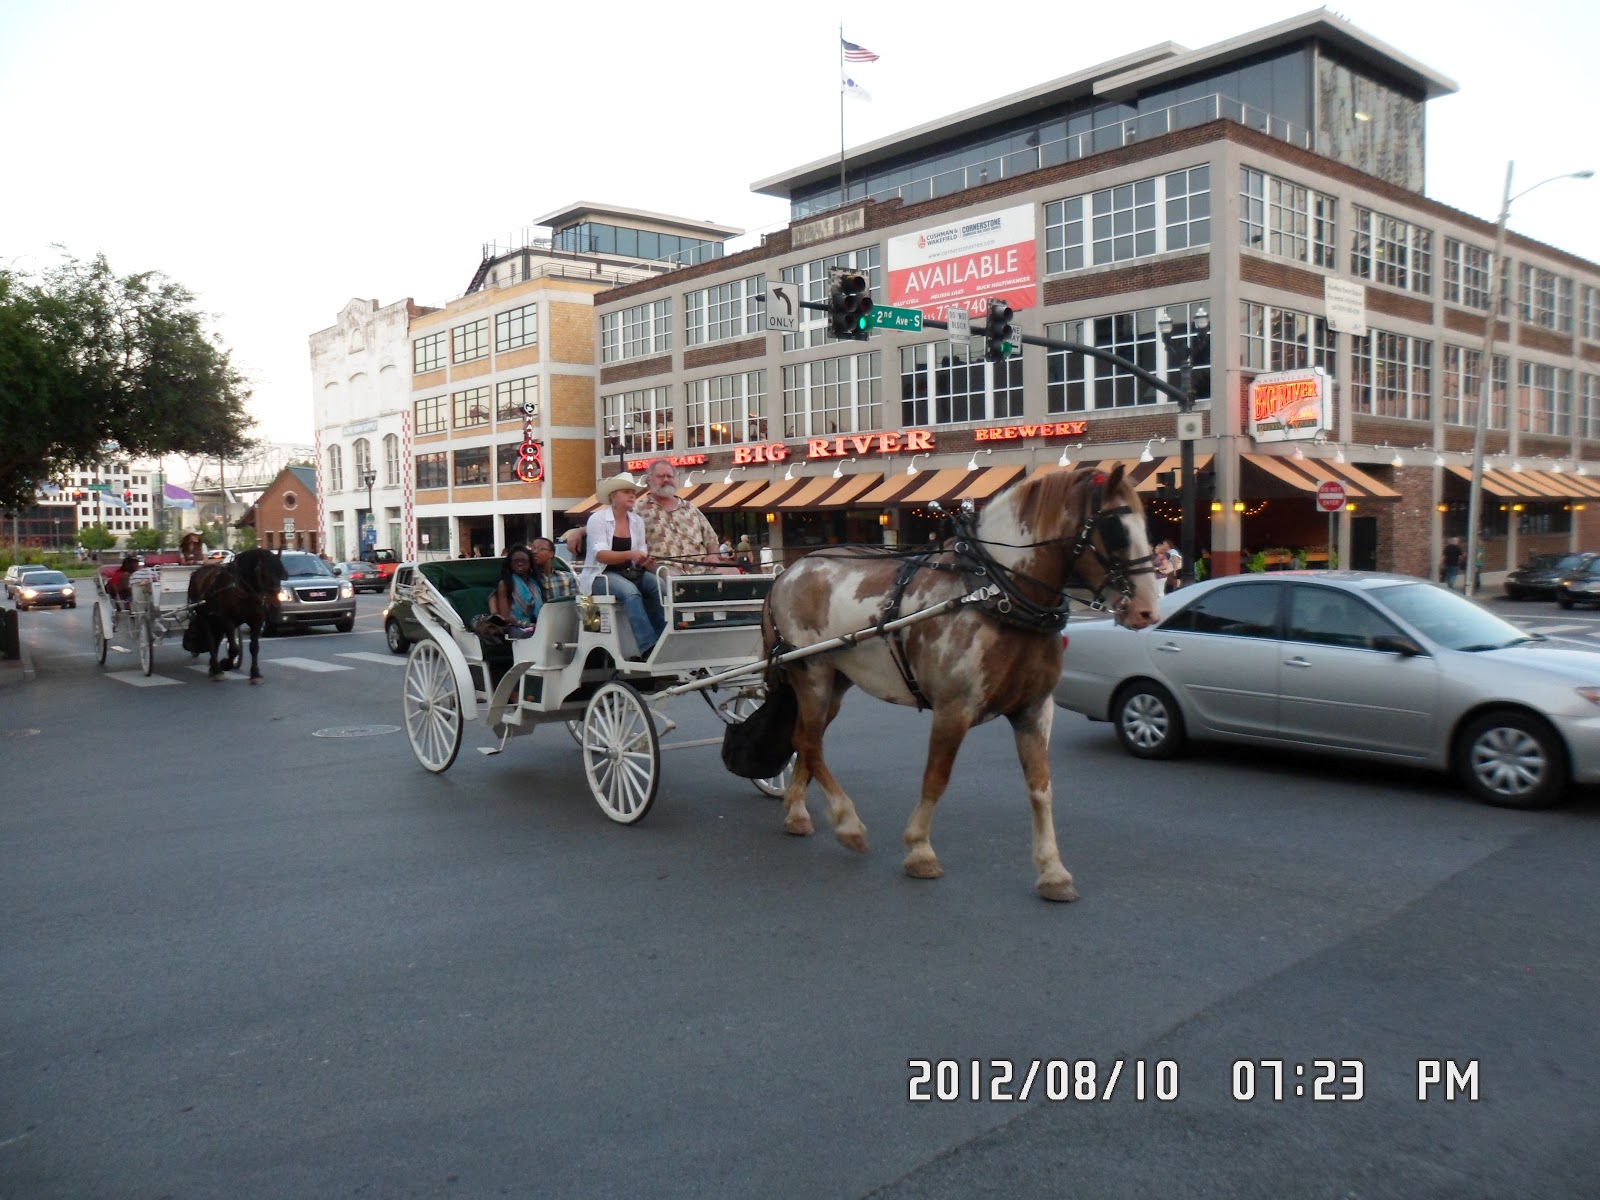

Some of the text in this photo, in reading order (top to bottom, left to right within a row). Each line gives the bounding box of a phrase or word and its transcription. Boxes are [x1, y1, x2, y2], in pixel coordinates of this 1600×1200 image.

[962, 217, 1001, 234] CORNERSTONE
[926, 229, 954, 241] CUSHMAN
[927, 234, 958, 246] WAKEFIELD
[905, 249, 1018, 293] AVAILABLE
[769, 316, 795, 328] ONLY
[895, 316, 908, 326] Ave
[958, 312, 967, 321] NOT
[951, 320, 967, 330] BLOCK
[1254, 381, 1318, 421] BIG RIVER
[974, 421, 1087, 442] BREWERY
[525, 415, 535, 478] NATIONAL
[733, 429, 935, 464] BIG RIVER
